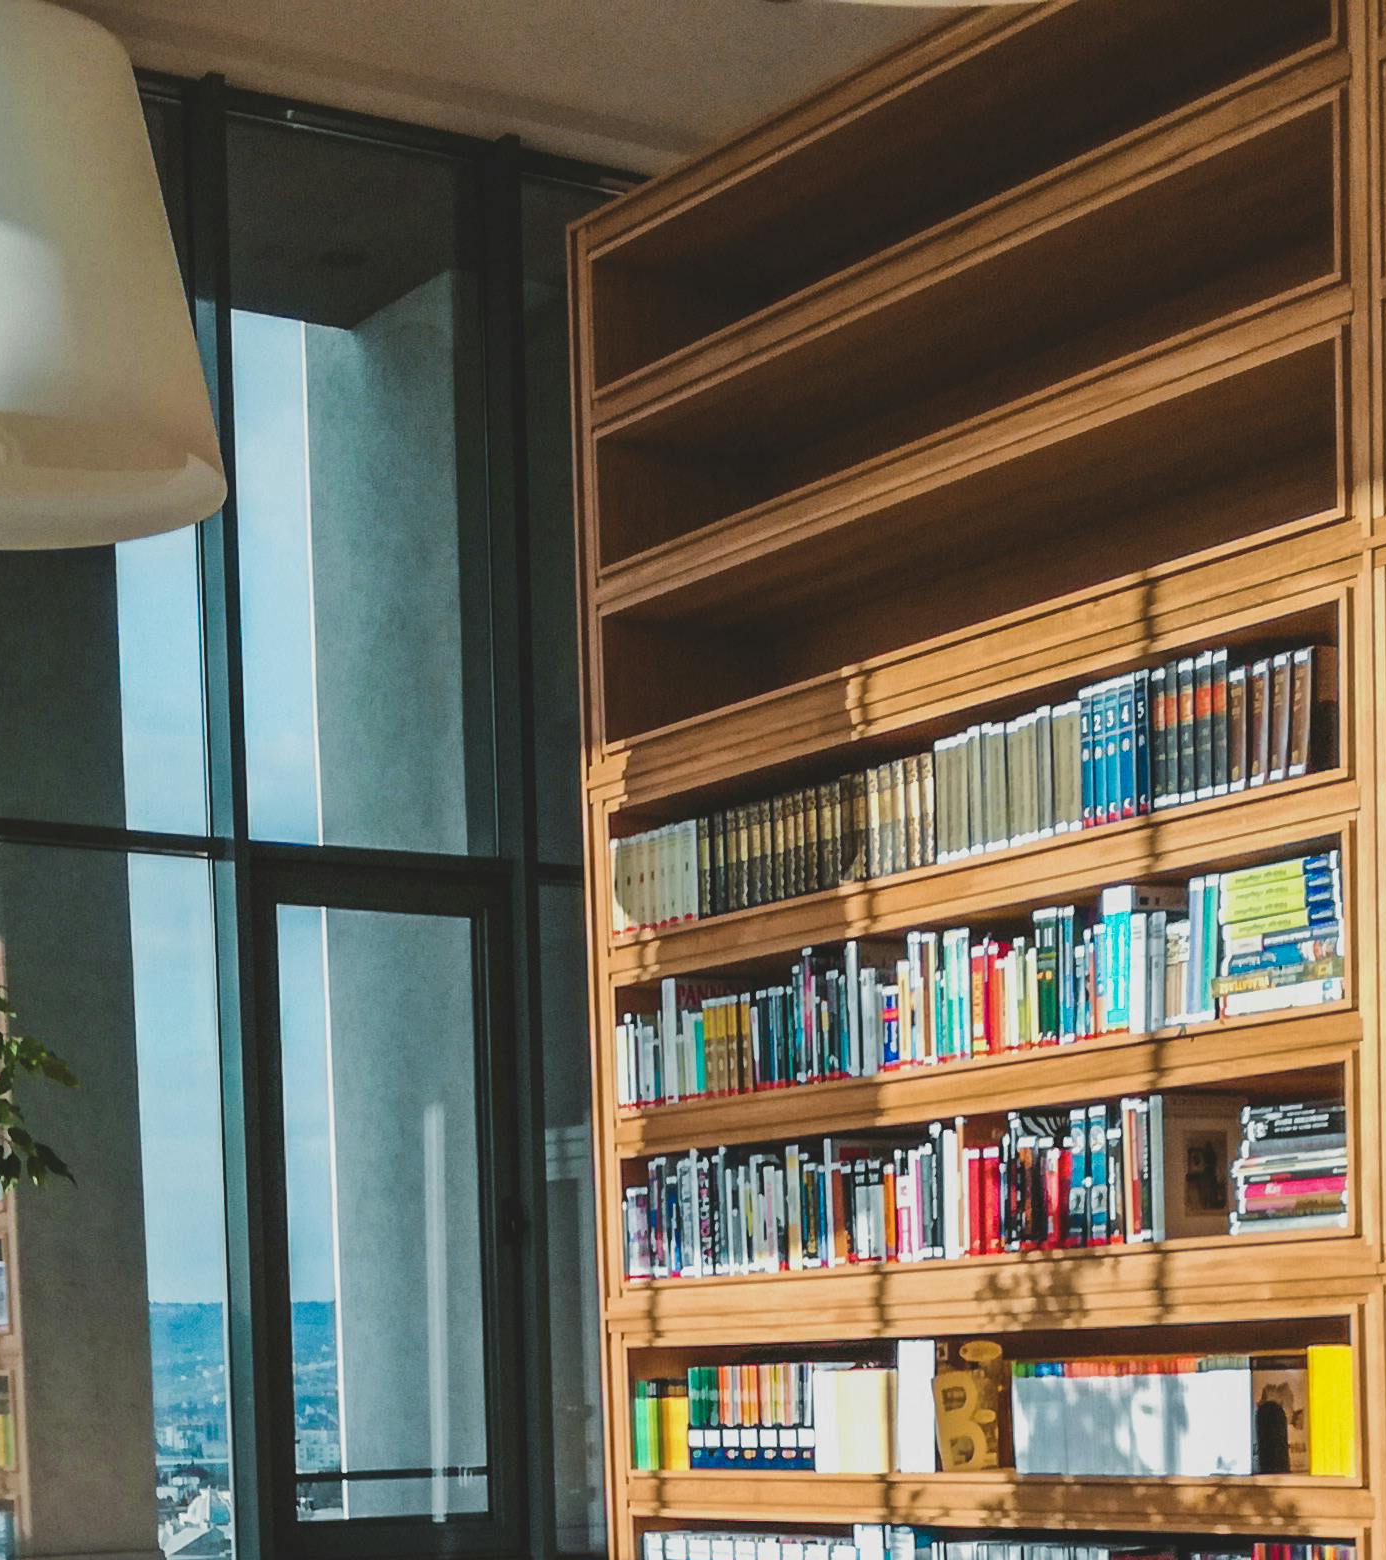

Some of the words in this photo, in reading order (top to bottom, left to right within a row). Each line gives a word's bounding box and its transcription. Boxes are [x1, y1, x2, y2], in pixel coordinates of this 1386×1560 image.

[1106, 709, 1114, 727] 3
[1121, 704, 1130, 722] 4
[1137, 701, 1145, 719] 5
[1093, 714, 1102, 732] 2
